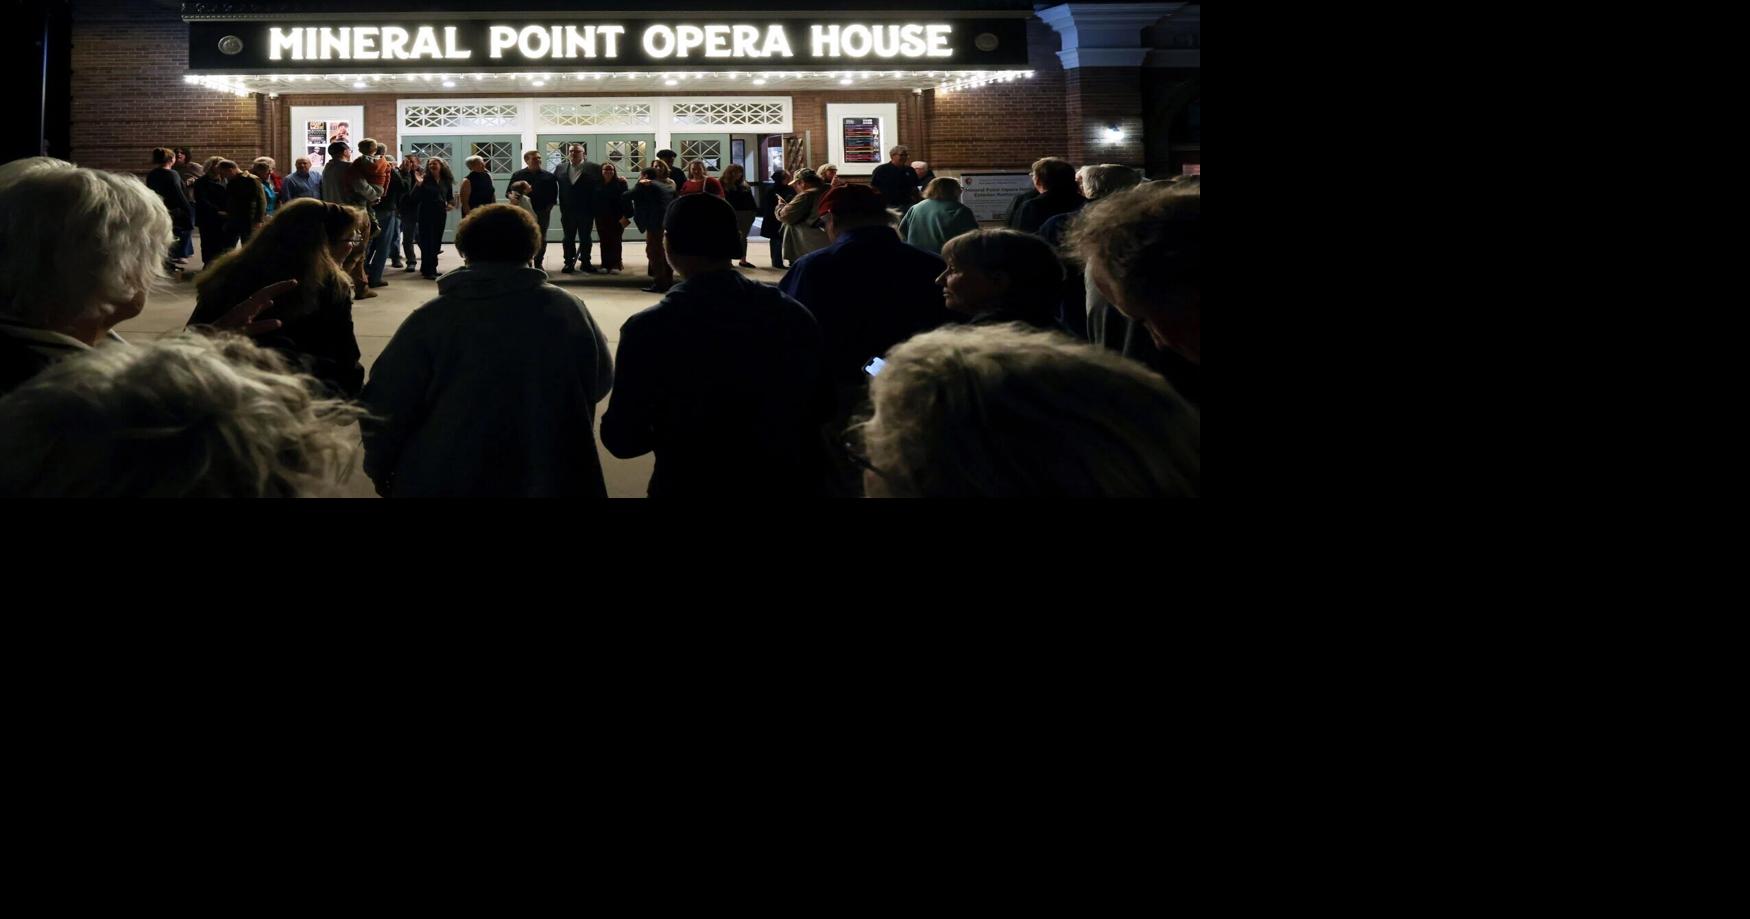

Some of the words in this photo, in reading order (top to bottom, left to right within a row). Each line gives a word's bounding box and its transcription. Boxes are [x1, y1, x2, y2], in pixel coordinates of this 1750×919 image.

[269, 26, 471, 60] MINERAL
[490, 25, 625, 59] POINT
[642, 24, 794, 59] OPERA
[810, 23, 953, 58] HOUSE
